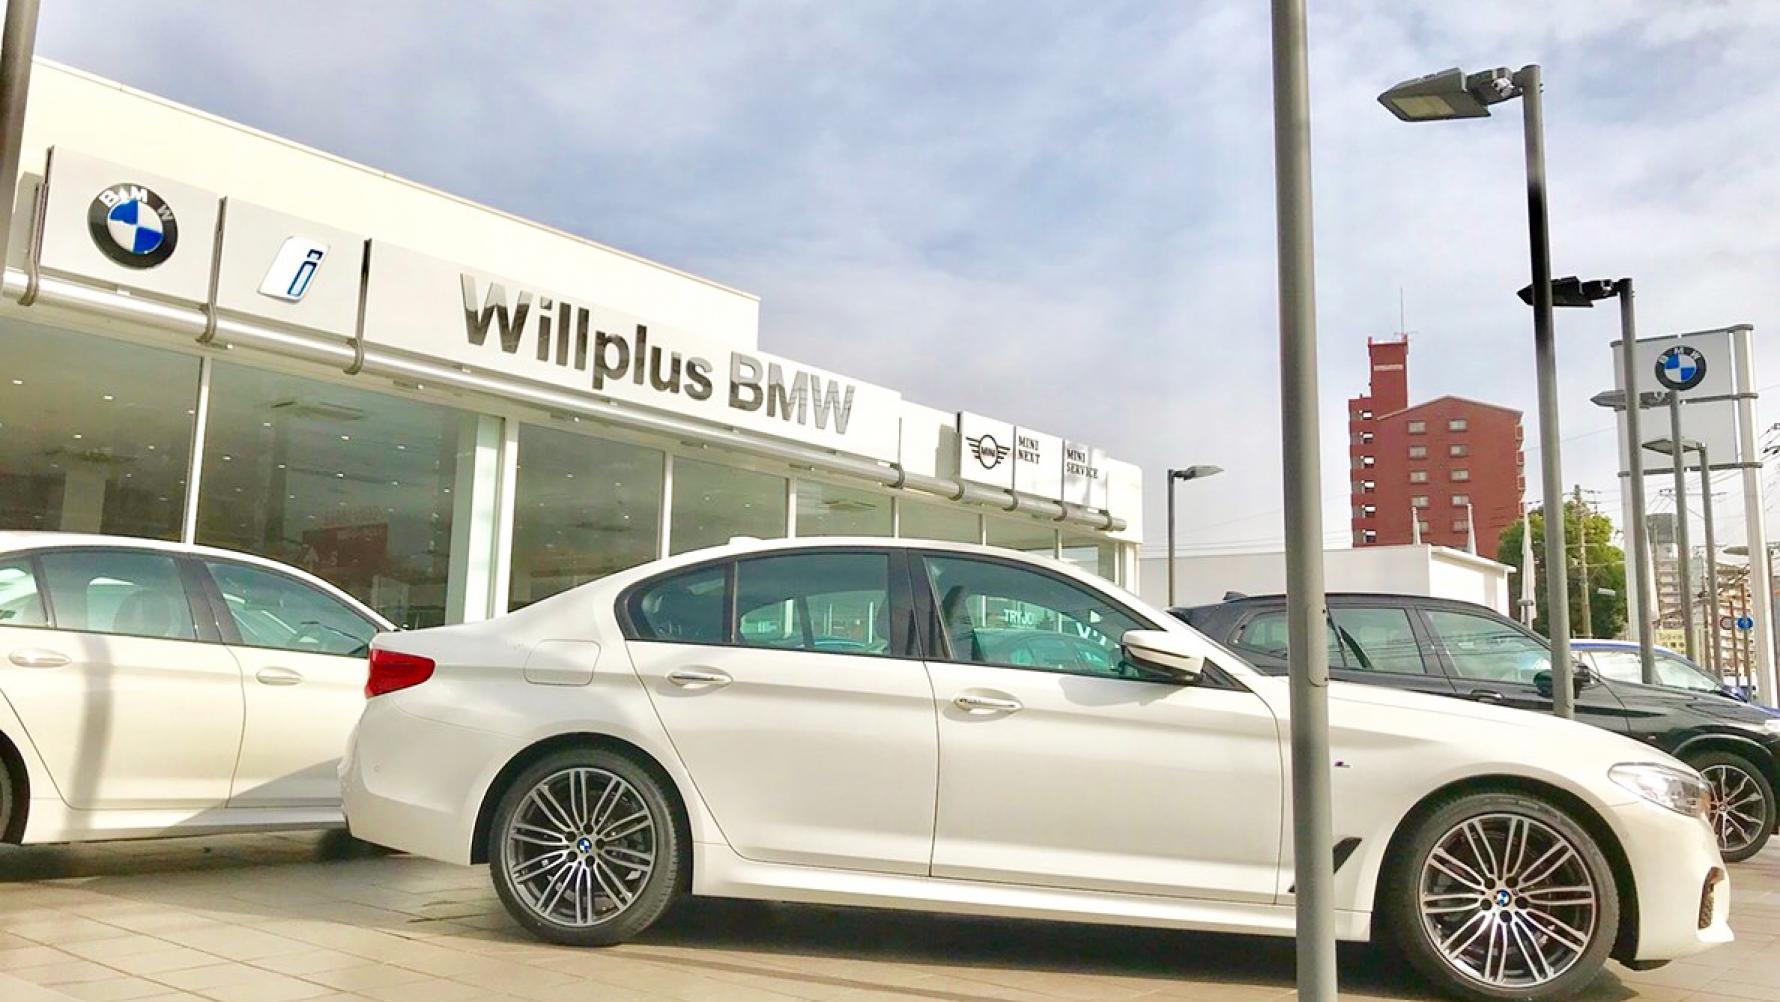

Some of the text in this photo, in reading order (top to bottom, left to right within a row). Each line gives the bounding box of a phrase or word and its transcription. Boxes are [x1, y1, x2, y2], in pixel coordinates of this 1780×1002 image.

[99, 185, 174, 221] BMW
[460, 272, 856, 435] Willplus BMW
[1658, 347, 1701, 364] BMW
[1018, 434, 1039, 451] MINI
[1017, 448, 1041, 464] NEXT
[1066, 448, 1086, 464] MINI
[1066, 461, 1098, 479] SERVICE
